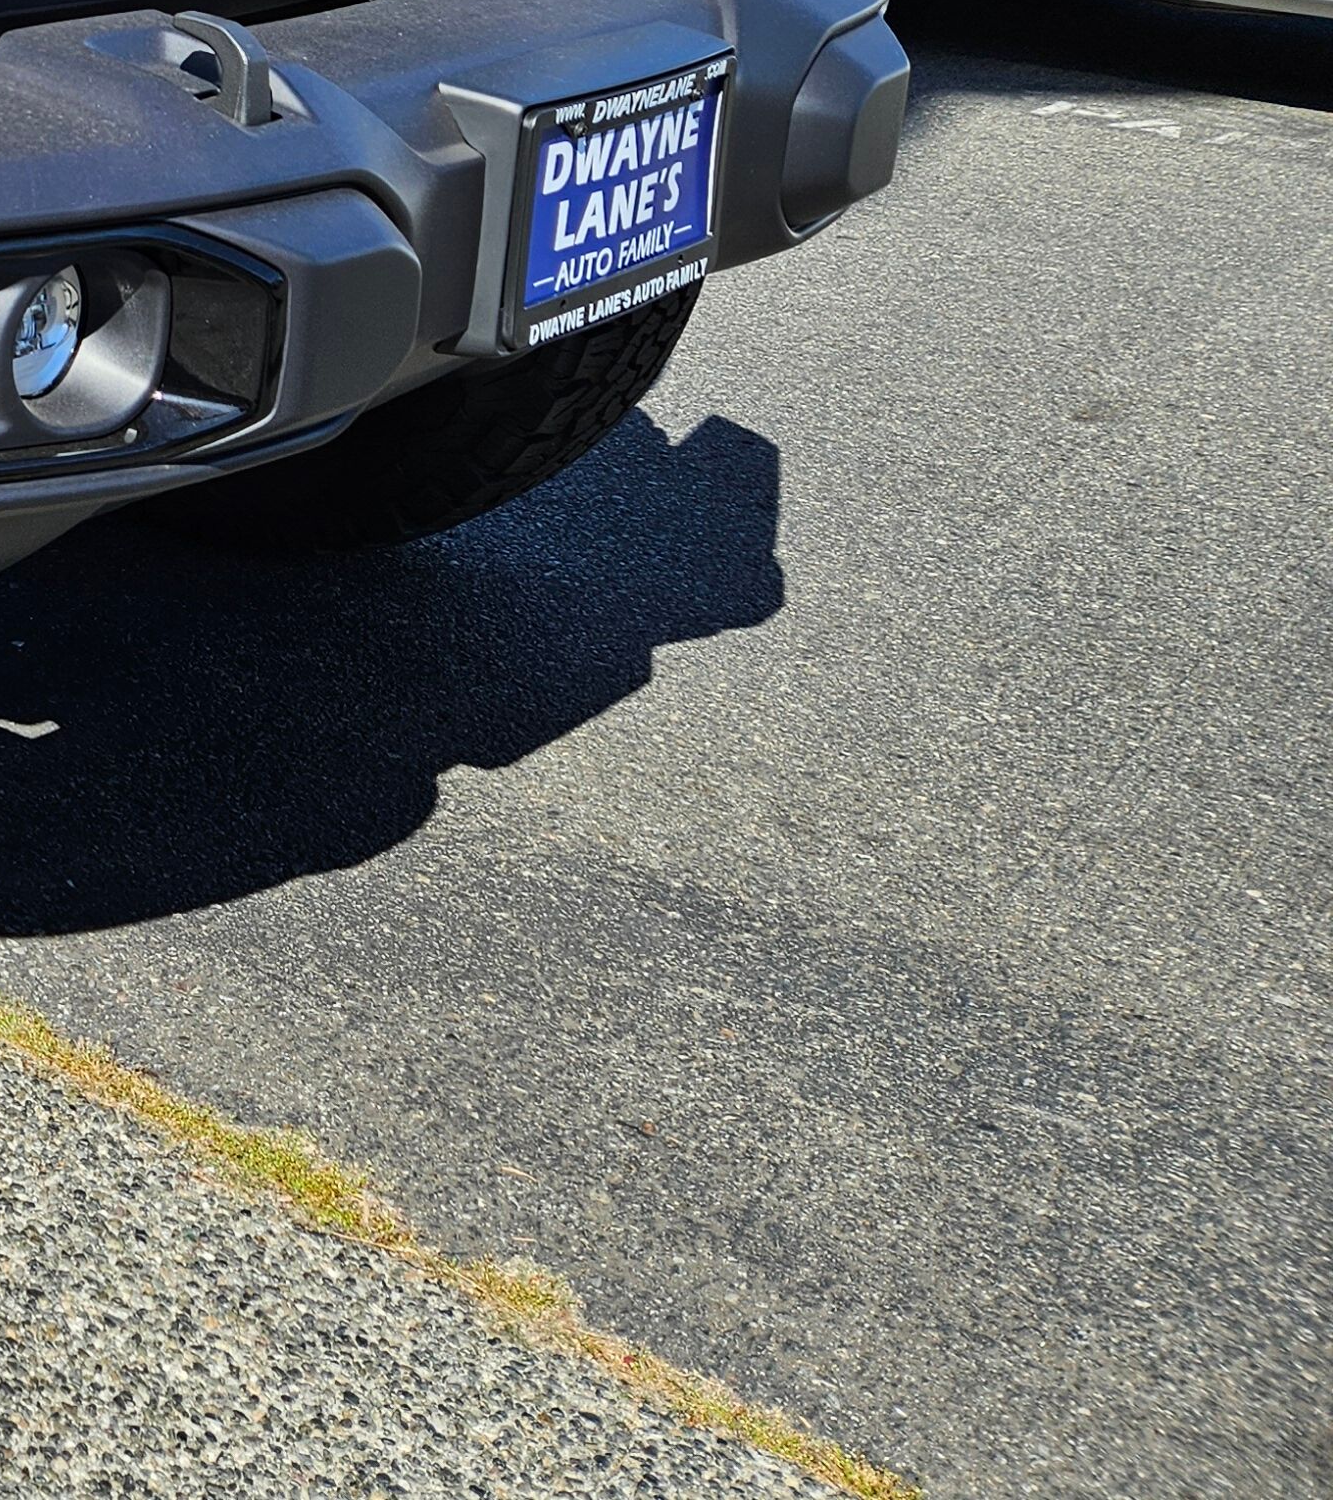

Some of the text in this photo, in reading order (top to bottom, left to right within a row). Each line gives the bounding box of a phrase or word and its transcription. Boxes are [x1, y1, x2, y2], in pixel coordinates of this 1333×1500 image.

[592, 73, 696, 123] DWAYNELANE
[542, 99, 704, 196] DWAYNE
[553, 161, 683, 252] LANE'S
[554, 220, 675, 292] AUTO FAMILY
[529, 257, 709, 346] DWAYNE LANE'S AUTO FAMILY
